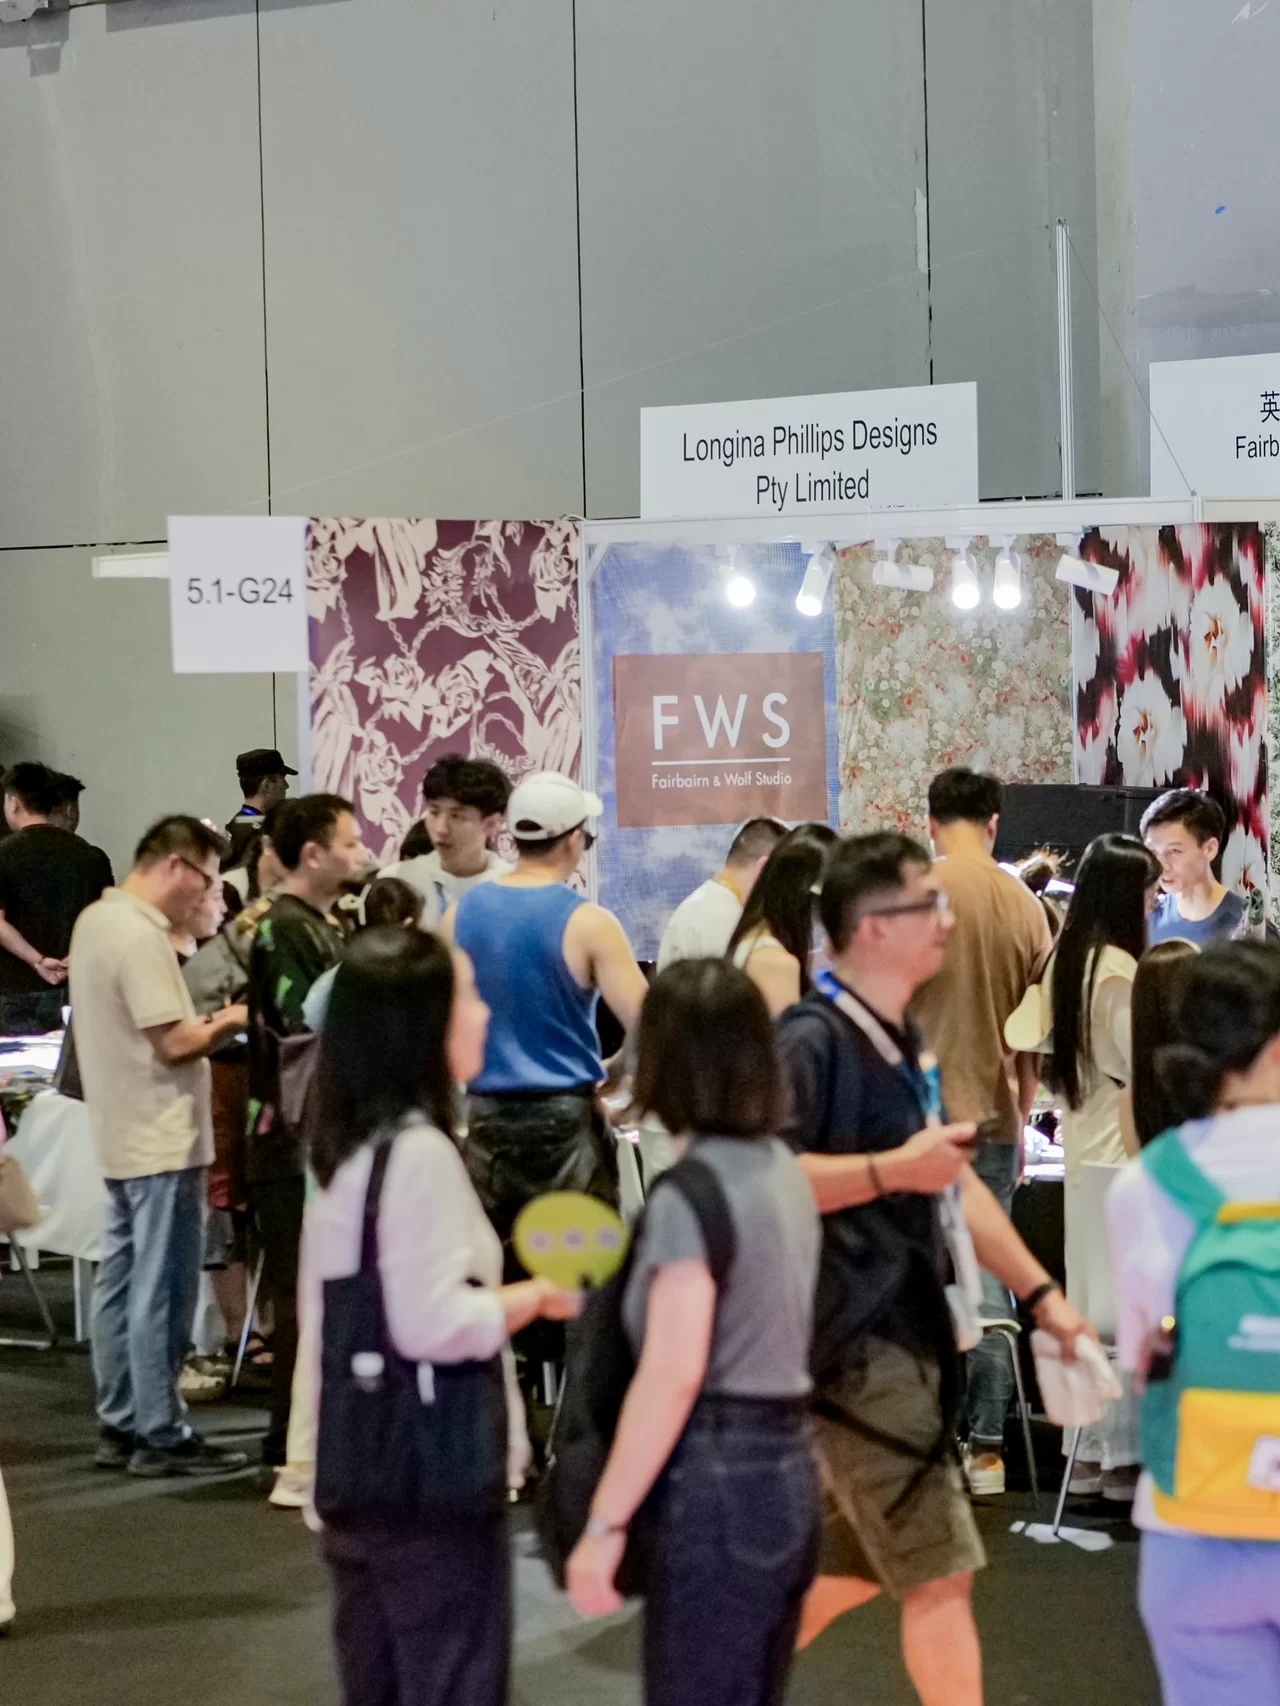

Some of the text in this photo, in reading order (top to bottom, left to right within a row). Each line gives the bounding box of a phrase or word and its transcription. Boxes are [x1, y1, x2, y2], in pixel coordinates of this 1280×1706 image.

[683, 417, 938, 467] Longina Phillips Designs
[757, 468, 869, 512] Pty Limited
[187, 577, 294, 605] 5.1-G24
[652, 692, 791, 750] FWS
[651, 770, 792, 789] Fairbairn & Wolf Studio
